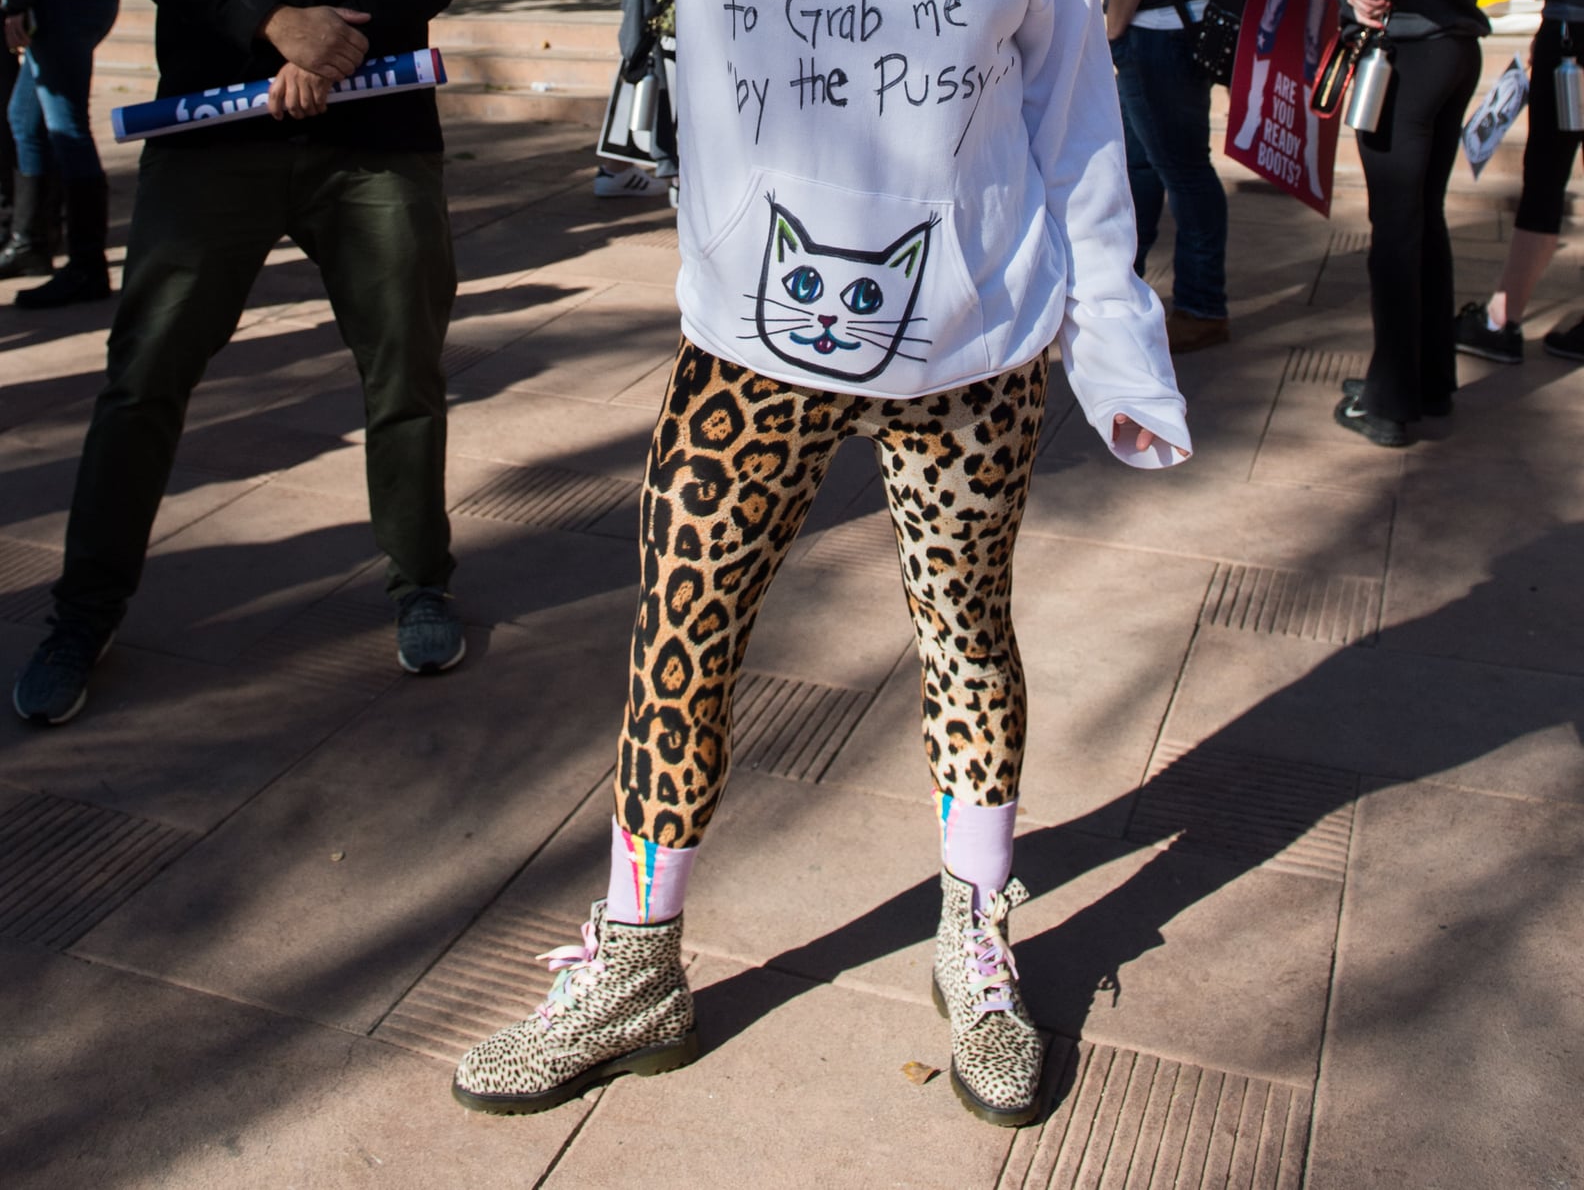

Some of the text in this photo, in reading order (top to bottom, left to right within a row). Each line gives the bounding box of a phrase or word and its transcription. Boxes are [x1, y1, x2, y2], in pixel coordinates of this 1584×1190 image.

[790, 57, 849, 110] the
[1273, 71, 1298, 105] ARE
[1272, 95, 1296, 130] YOU
[1263, 117, 1302, 160] READY
[1257, 140, 1303, 188] BOOTS?
